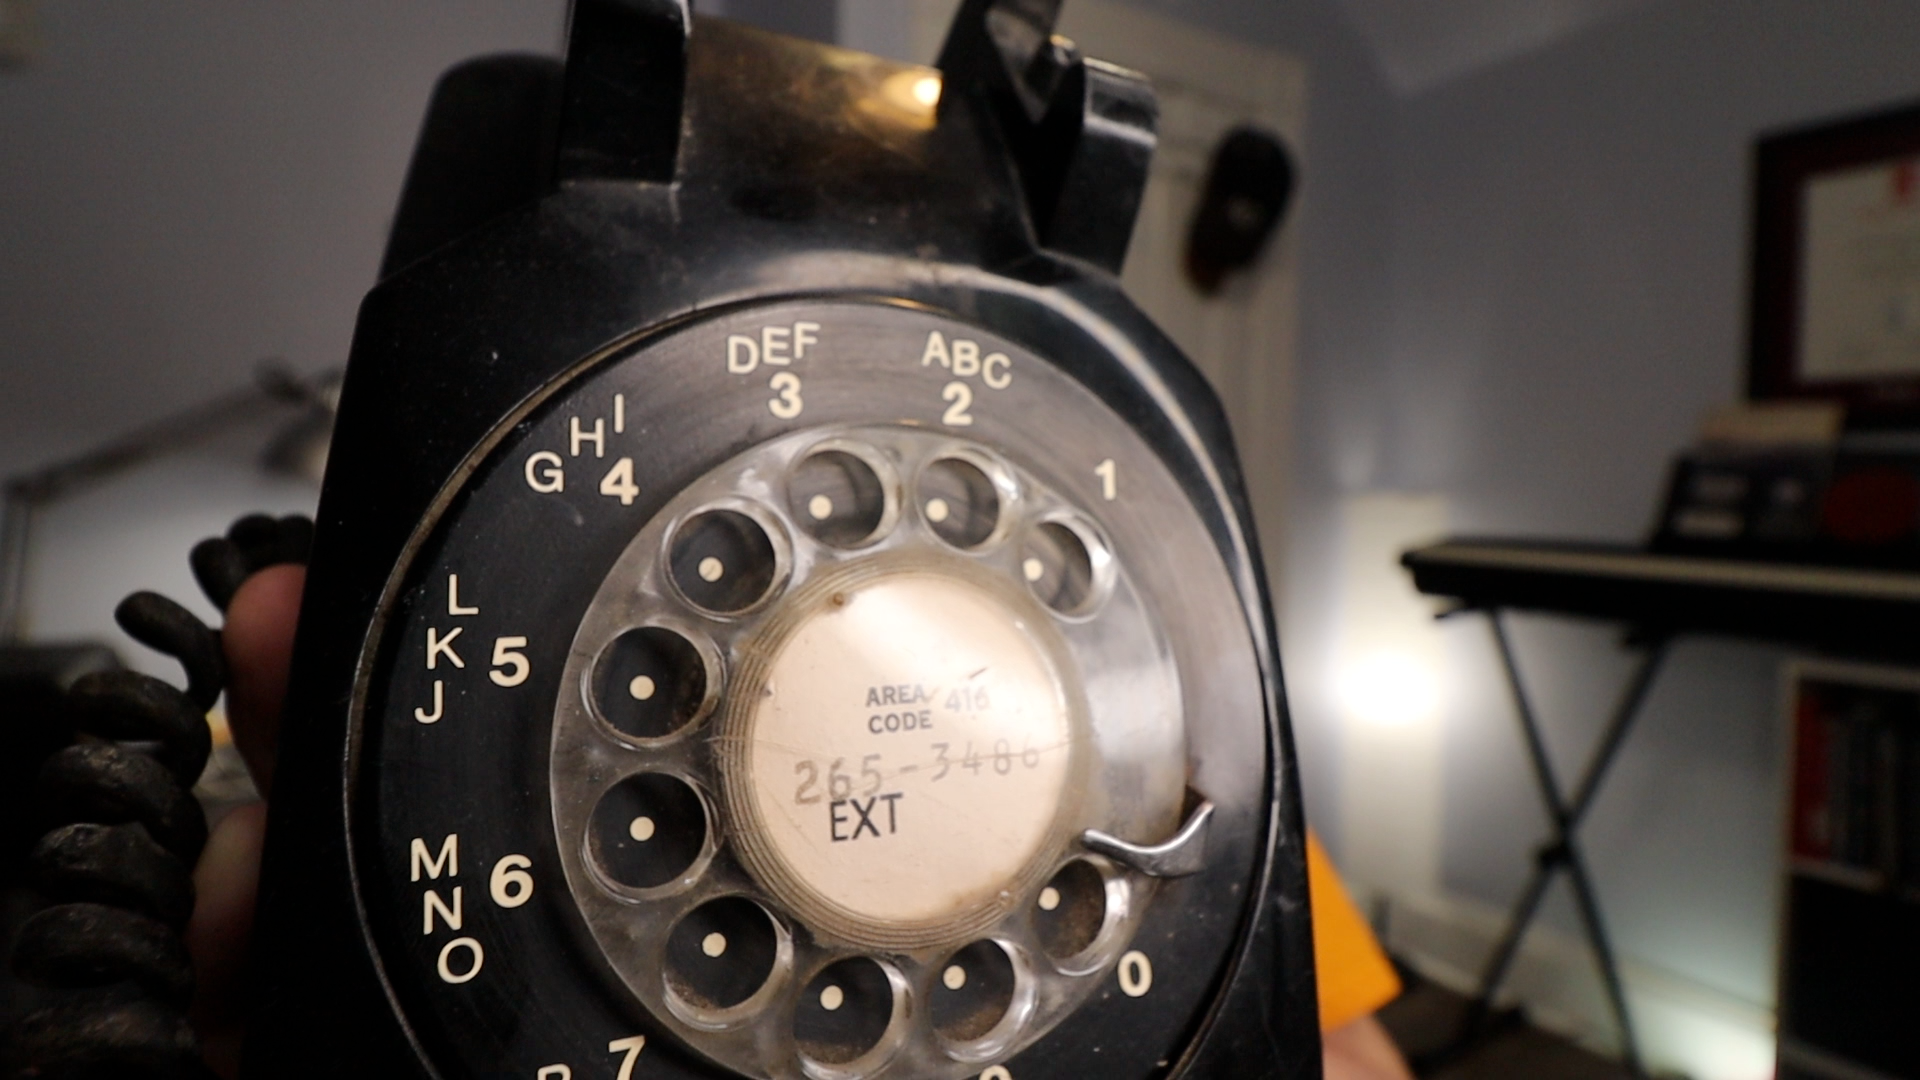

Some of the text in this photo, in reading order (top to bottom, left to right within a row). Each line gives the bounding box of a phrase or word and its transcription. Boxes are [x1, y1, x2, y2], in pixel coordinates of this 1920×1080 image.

[727, 322, 821, 373] DEF
[921, 330, 1012, 389] ABC
[768, 371, 804, 419] 3
[942, 381, 973, 425] 2
[600, 456, 640, 505] 4
[1094, 457, 1116, 501] 1
[489, 636, 531, 688] 5
[865, 683, 926, 708] AREA
[944, 685, 991, 713] 416
[867, 710, 934, 735] CODE
[829, 791, 905, 842] EXT
[489, 854, 535, 909] 6
[1117, 950, 1152, 997] 0
[608, 1035, 646, 1080] 7
